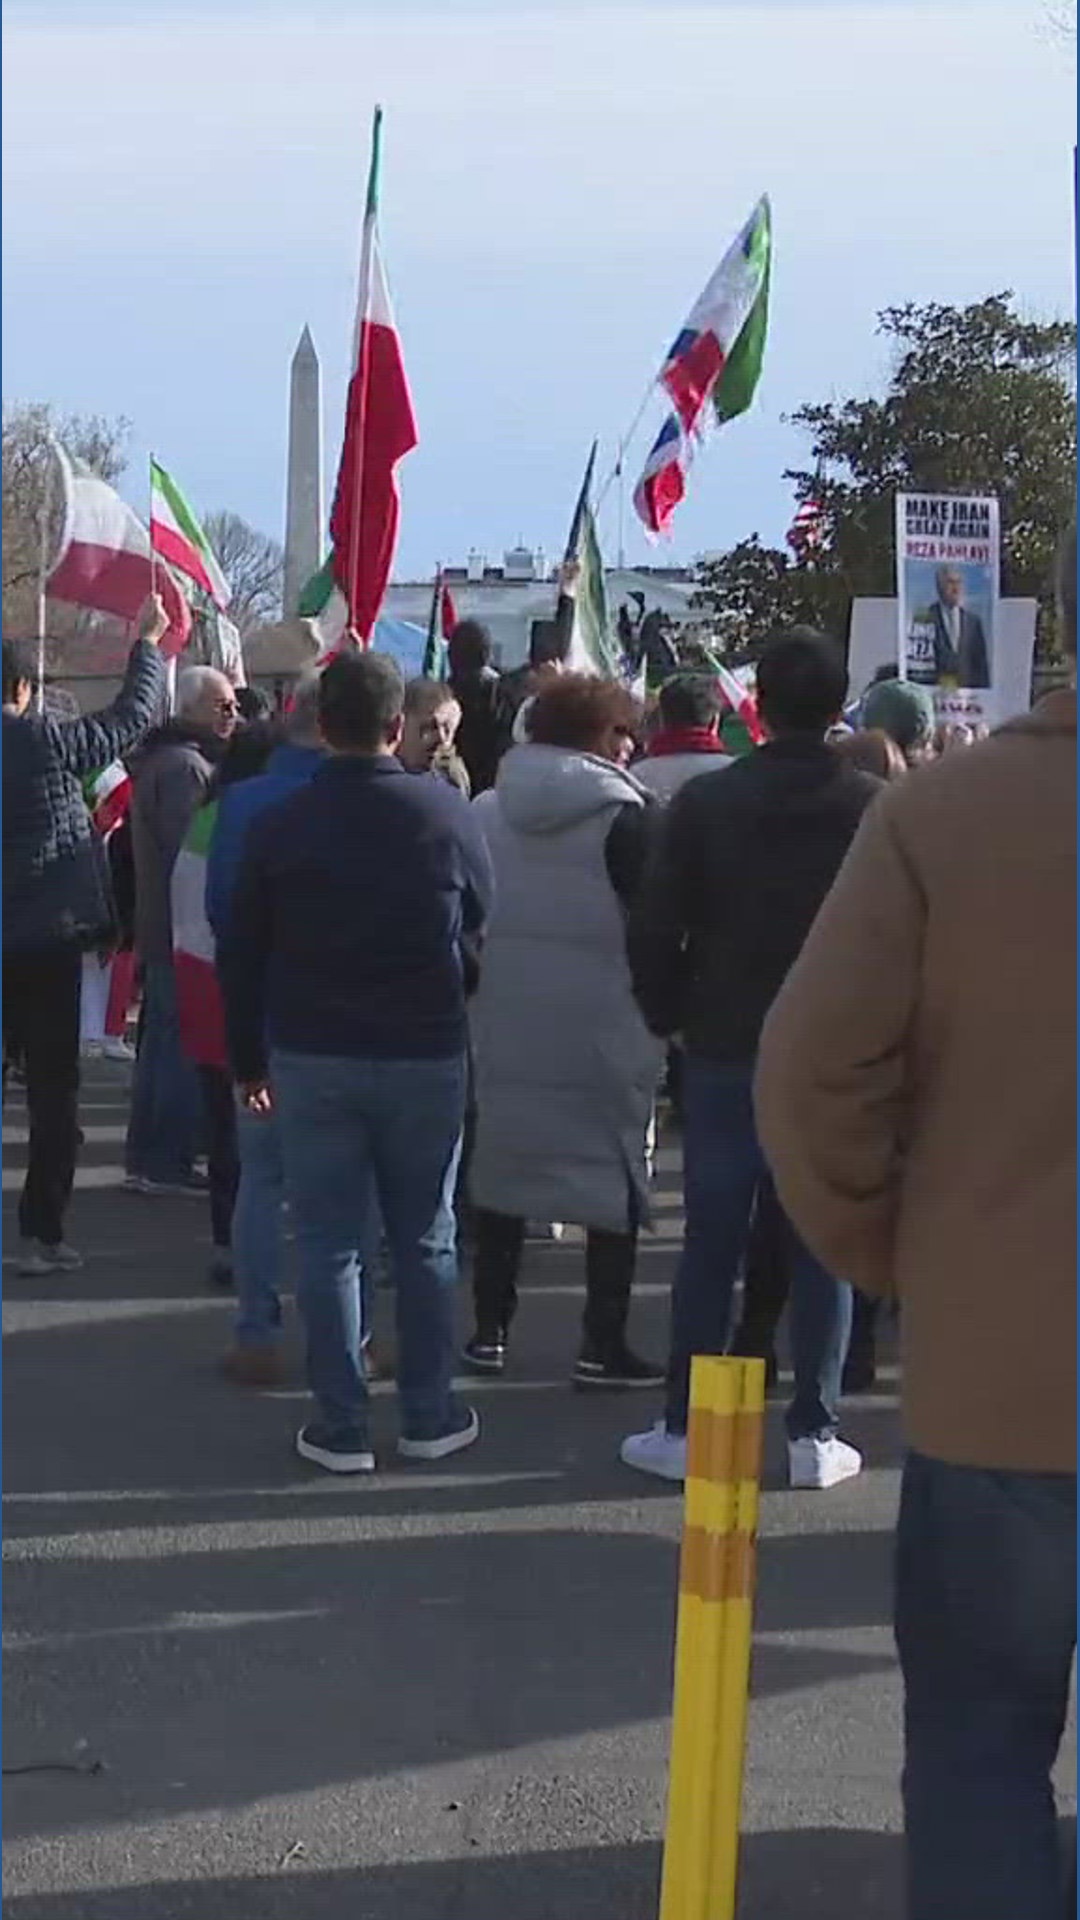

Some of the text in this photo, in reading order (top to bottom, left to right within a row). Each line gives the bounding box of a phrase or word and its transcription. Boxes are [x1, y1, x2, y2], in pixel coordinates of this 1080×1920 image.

[906, 498, 990, 521] MAKE IRAN
[906, 519, 990, 538] GREAT AGAIN
[906, 541, 990, 561] REZA PAHLAVI
